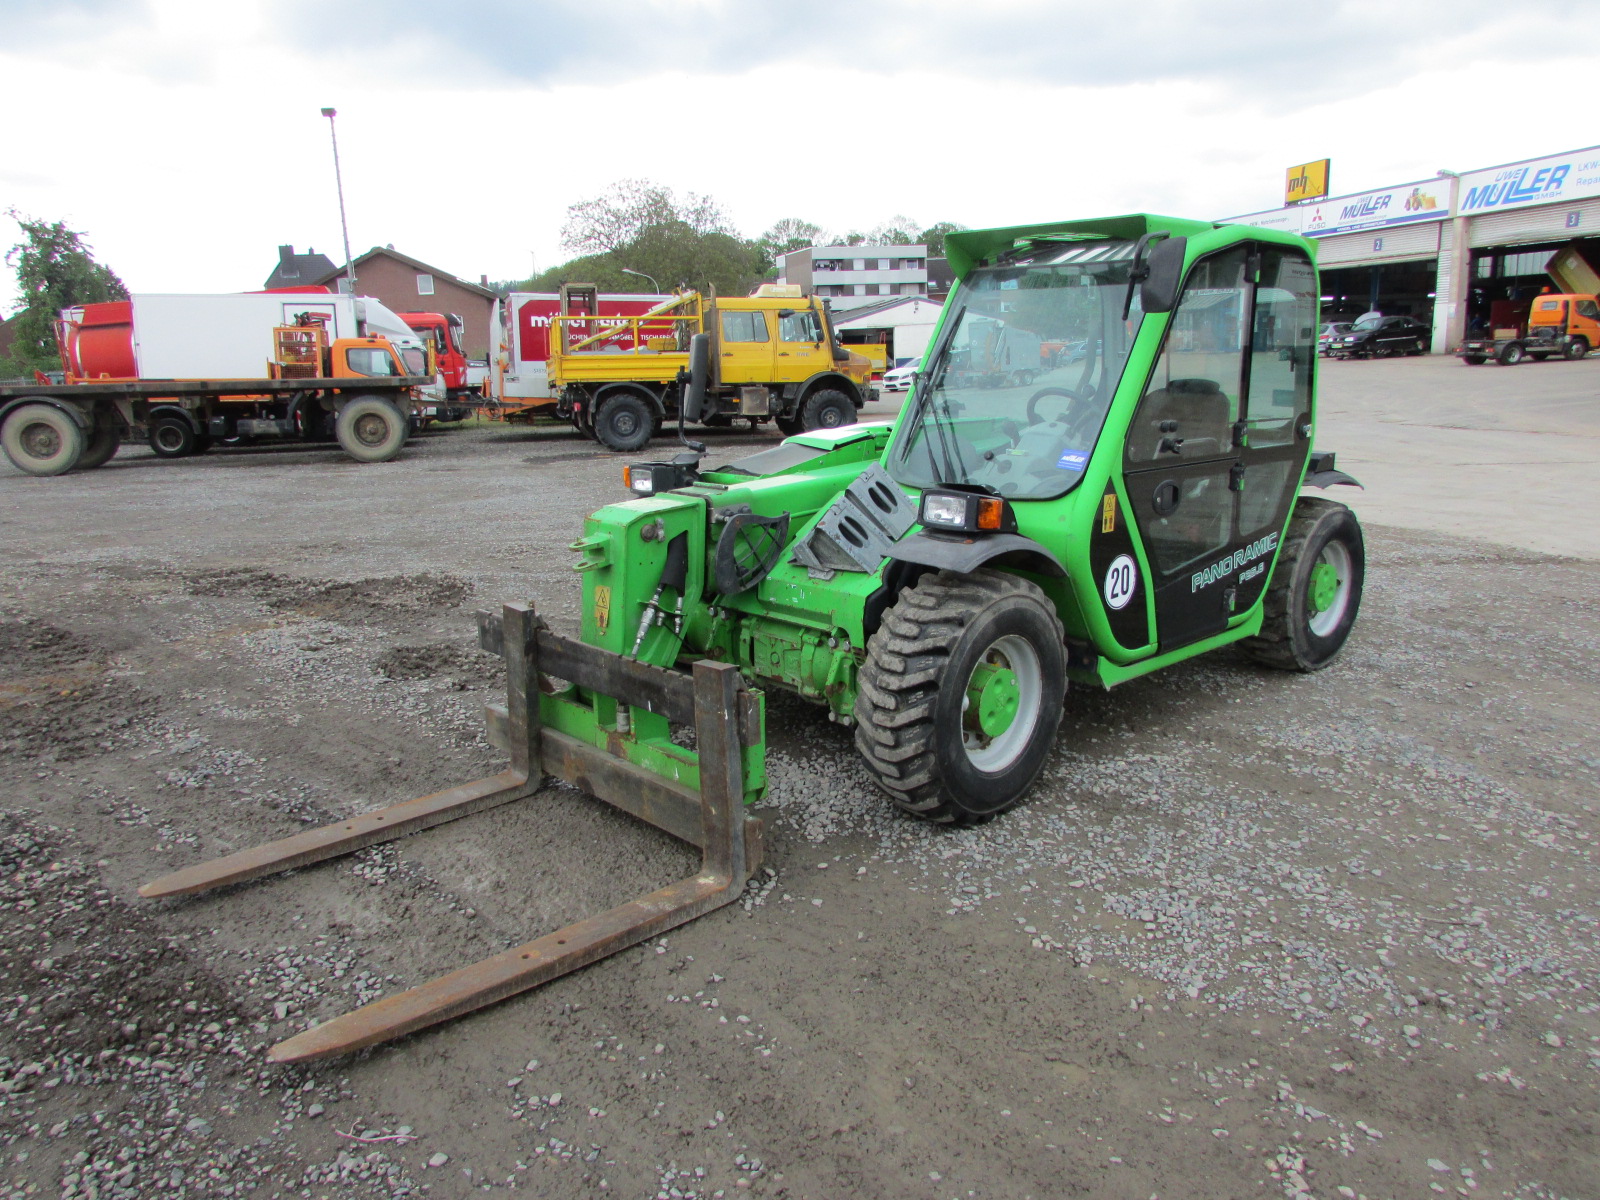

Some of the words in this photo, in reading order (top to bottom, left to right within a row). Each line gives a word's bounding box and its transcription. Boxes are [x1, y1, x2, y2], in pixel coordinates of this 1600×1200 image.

[1495, 169, 1522, 182] UWE
[1308, 222, 1326, 230] FUSO
[1110, 564, 1130, 600] 20
